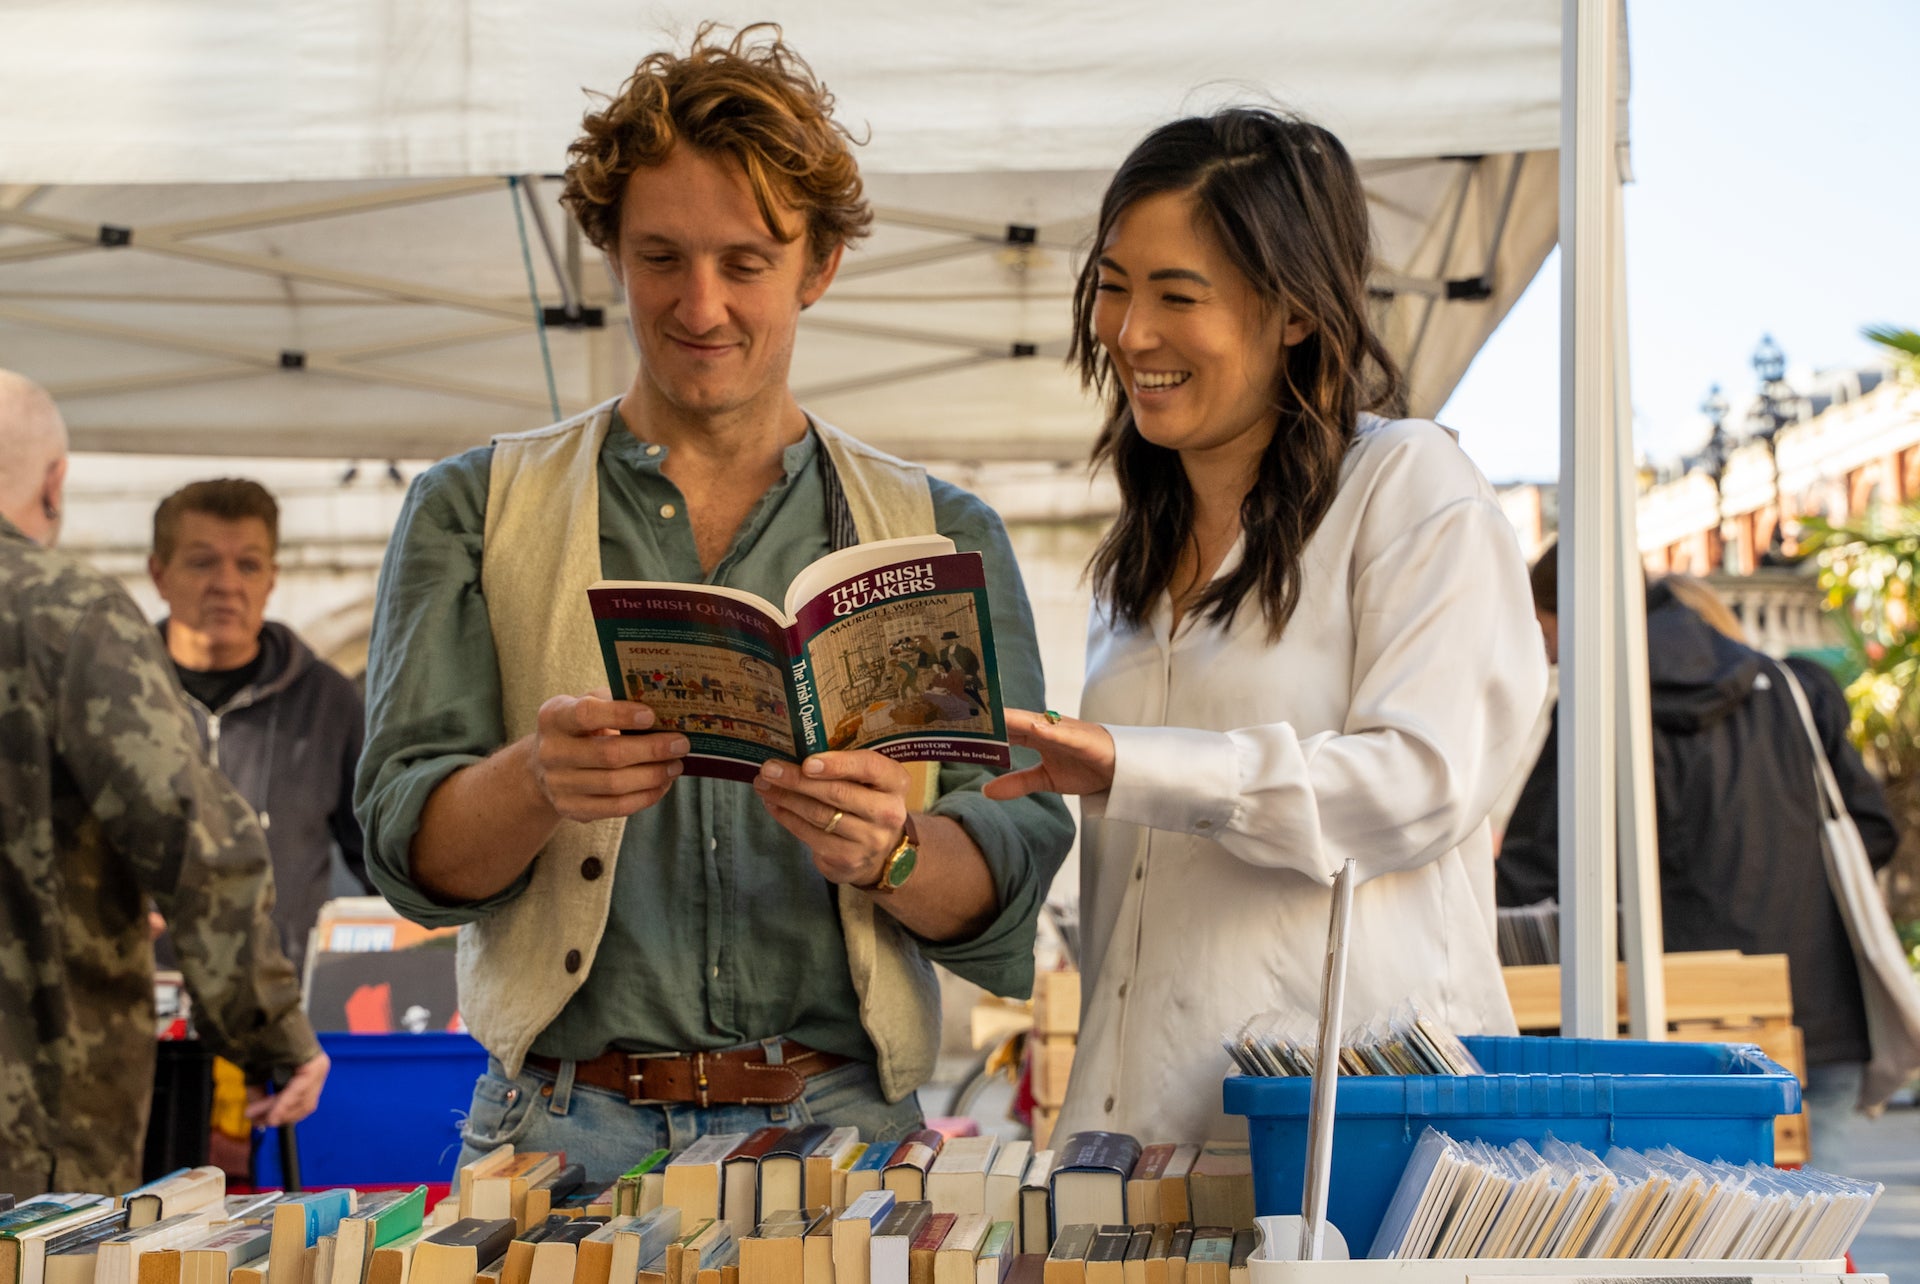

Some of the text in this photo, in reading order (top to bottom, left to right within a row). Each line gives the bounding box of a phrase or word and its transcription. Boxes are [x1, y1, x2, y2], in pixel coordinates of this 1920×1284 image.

[828, 563, 934, 604] THE IRISH
[833, 577, 936, 617] QUAKERS
[893, 598, 949, 612] WIGHAM
[612, 599, 770, 634] The IRISH QUAKERS
[628, 647, 671, 656] SERVICE
[792, 659, 819, 746] The Irish Quakers
[881, 742, 953, 754] SHORT HISTORY
[890, 749, 919, 759] Society
[931, 749, 961, 757] Friends
[972, 752, 1001, 761] Ireland
